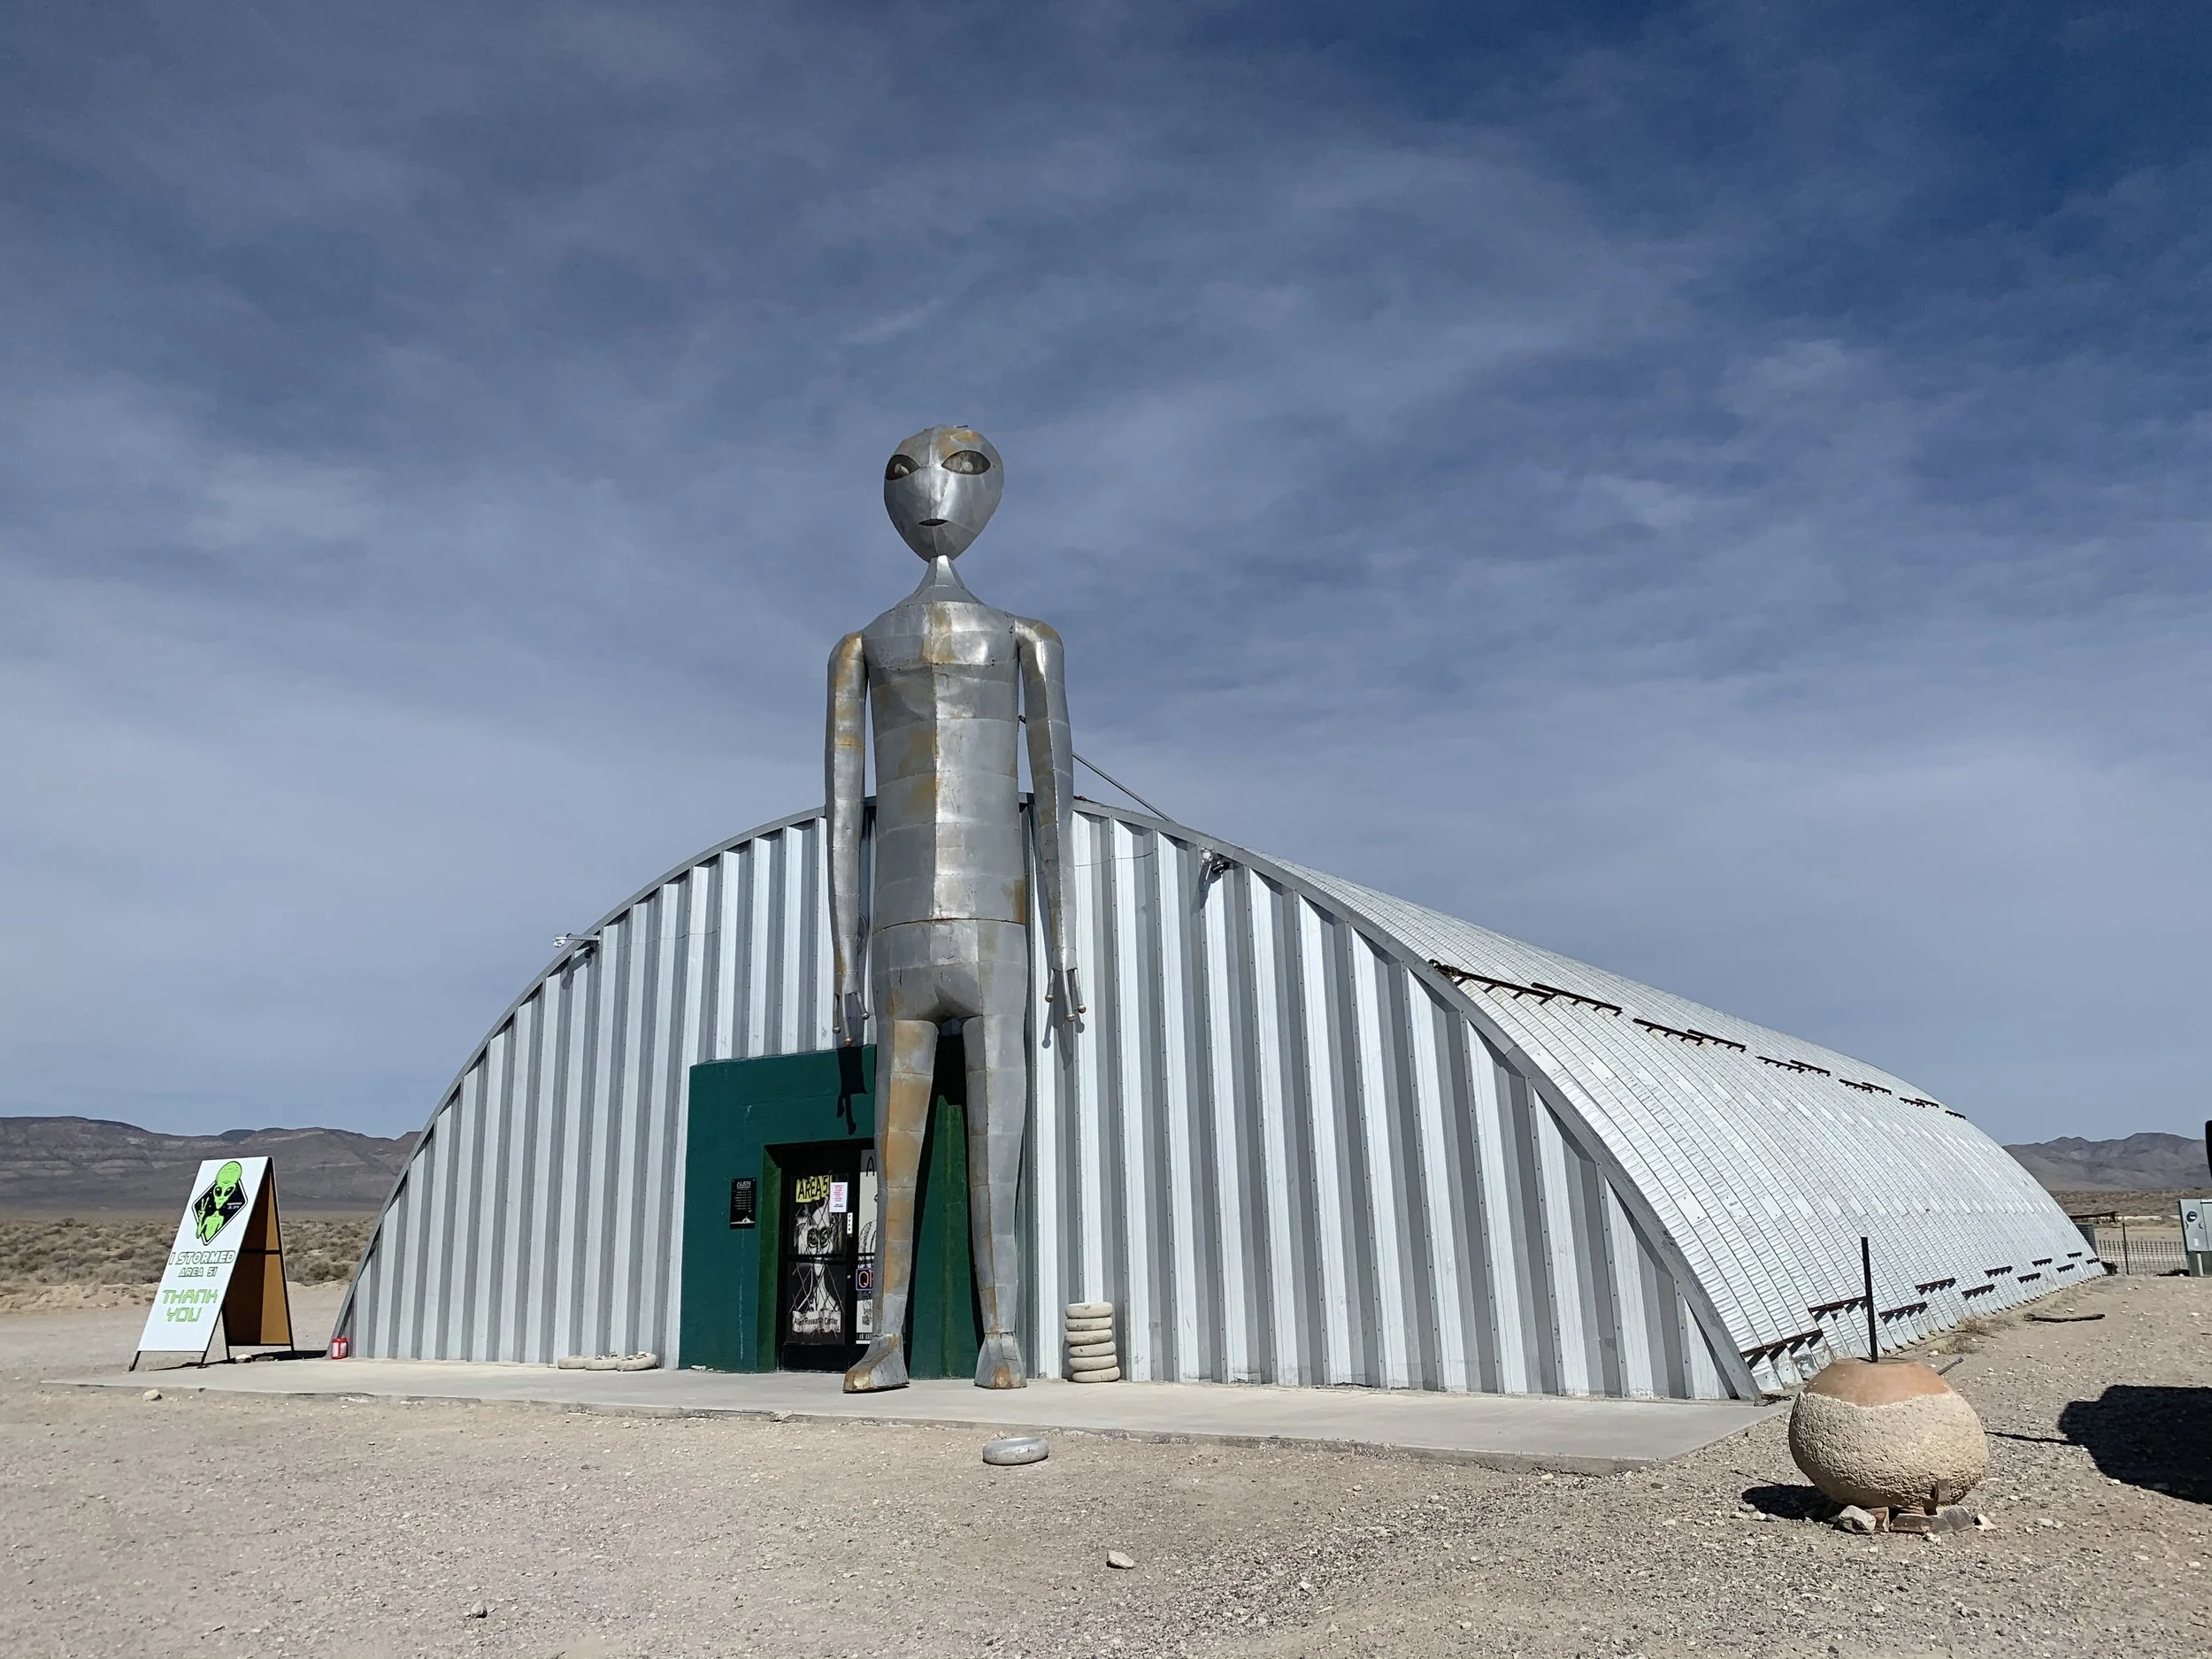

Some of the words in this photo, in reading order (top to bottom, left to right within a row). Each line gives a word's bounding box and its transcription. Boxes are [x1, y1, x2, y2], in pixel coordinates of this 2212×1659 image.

[798, 1177, 822, 1199] AREA
[168, 1252, 176, 1265] I
[175, 1250, 236, 1265] STORMED
[178, 1267, 204, 1278] AREA
[207, 1266, 219, 1278] 51
[163, 1289, 219, 1304] THANK
[166, 1307, 203, 1322] YOU
